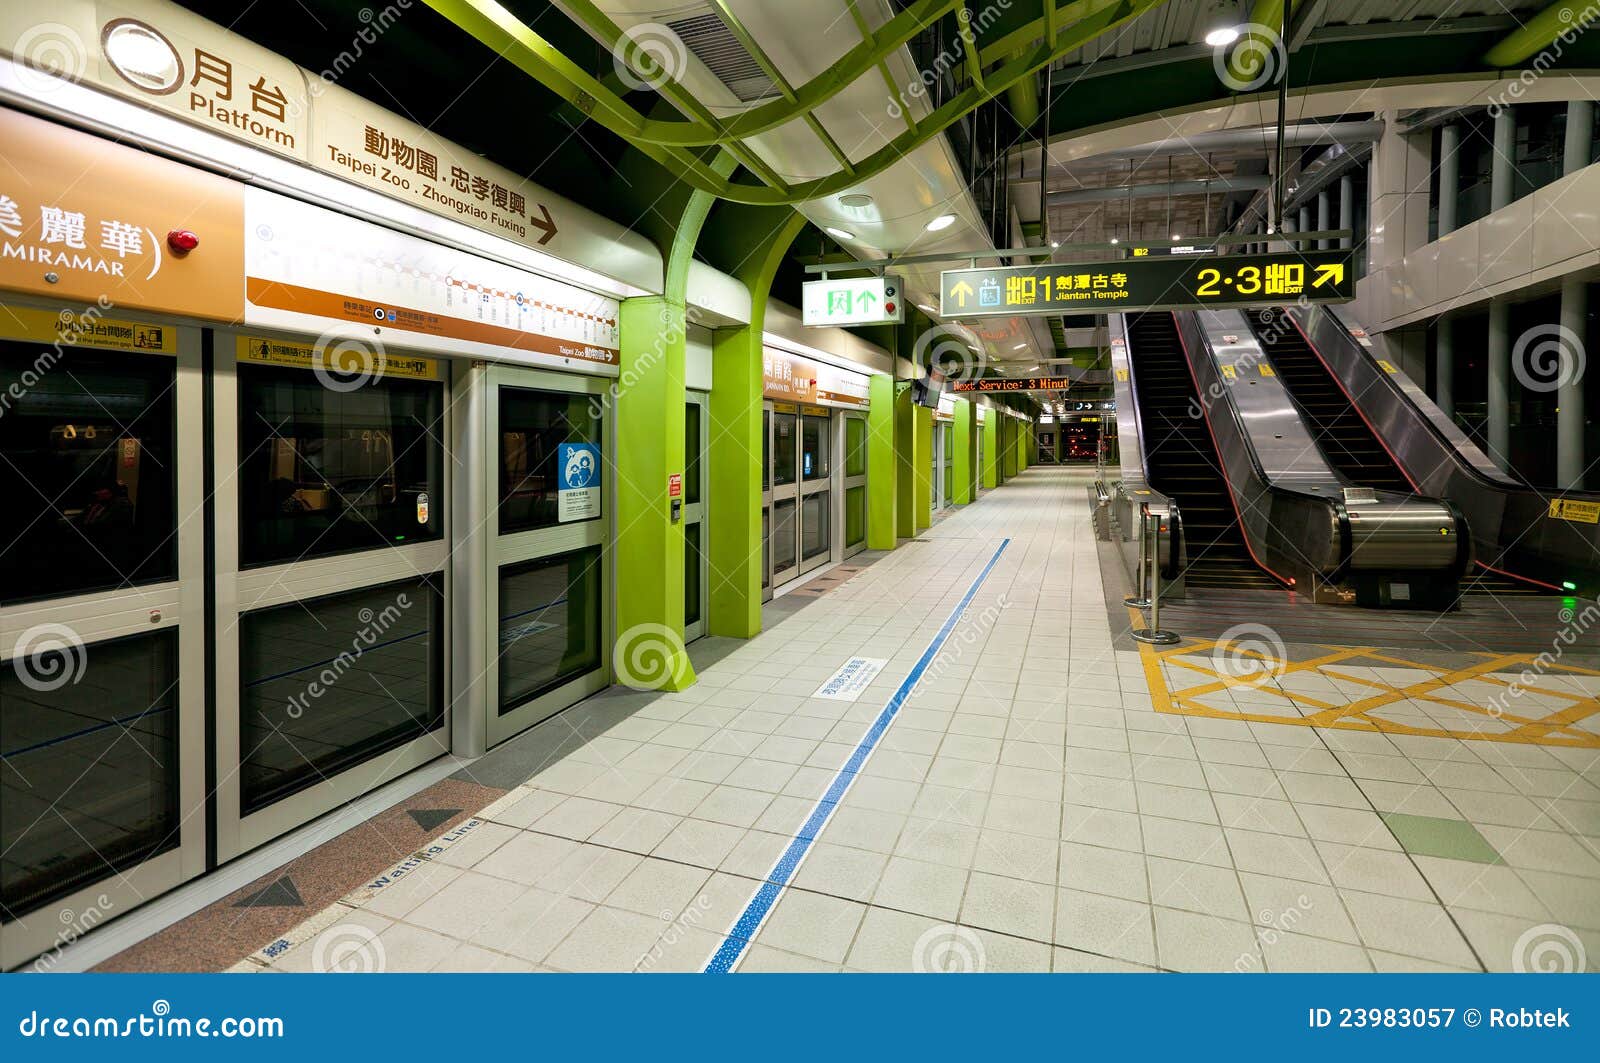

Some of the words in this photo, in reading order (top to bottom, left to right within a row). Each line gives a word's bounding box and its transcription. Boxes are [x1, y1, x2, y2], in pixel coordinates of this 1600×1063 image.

[190, 48, 288, 123] 月台
[191, 92, 295, 149] Platform
[328, 145, 377, 178] Taipei
[381, 167, 410, 190] Zoo
[423, 184, 488, 221] Zhongxiao
[491, 212, 526, 238] Fuxing
[2, 241, 125, 278] MIRAMAR
[1021, 296, 1035, 305] EXIT
[1055, 290, 1092, 301] Jiantan
[1092, 289, 1129, 300] Temple
[1285, 285, 1303, 294] EXIT
[953, 380, 976, 392] Next
[980, 378, 1024, 391] Service:
[1028, 378, 1036, 389] 3
[1040, 377, 1068, 389] Minut
[368, 844, 444, 890] Waiting
[443, 819, 480, 843] Line
